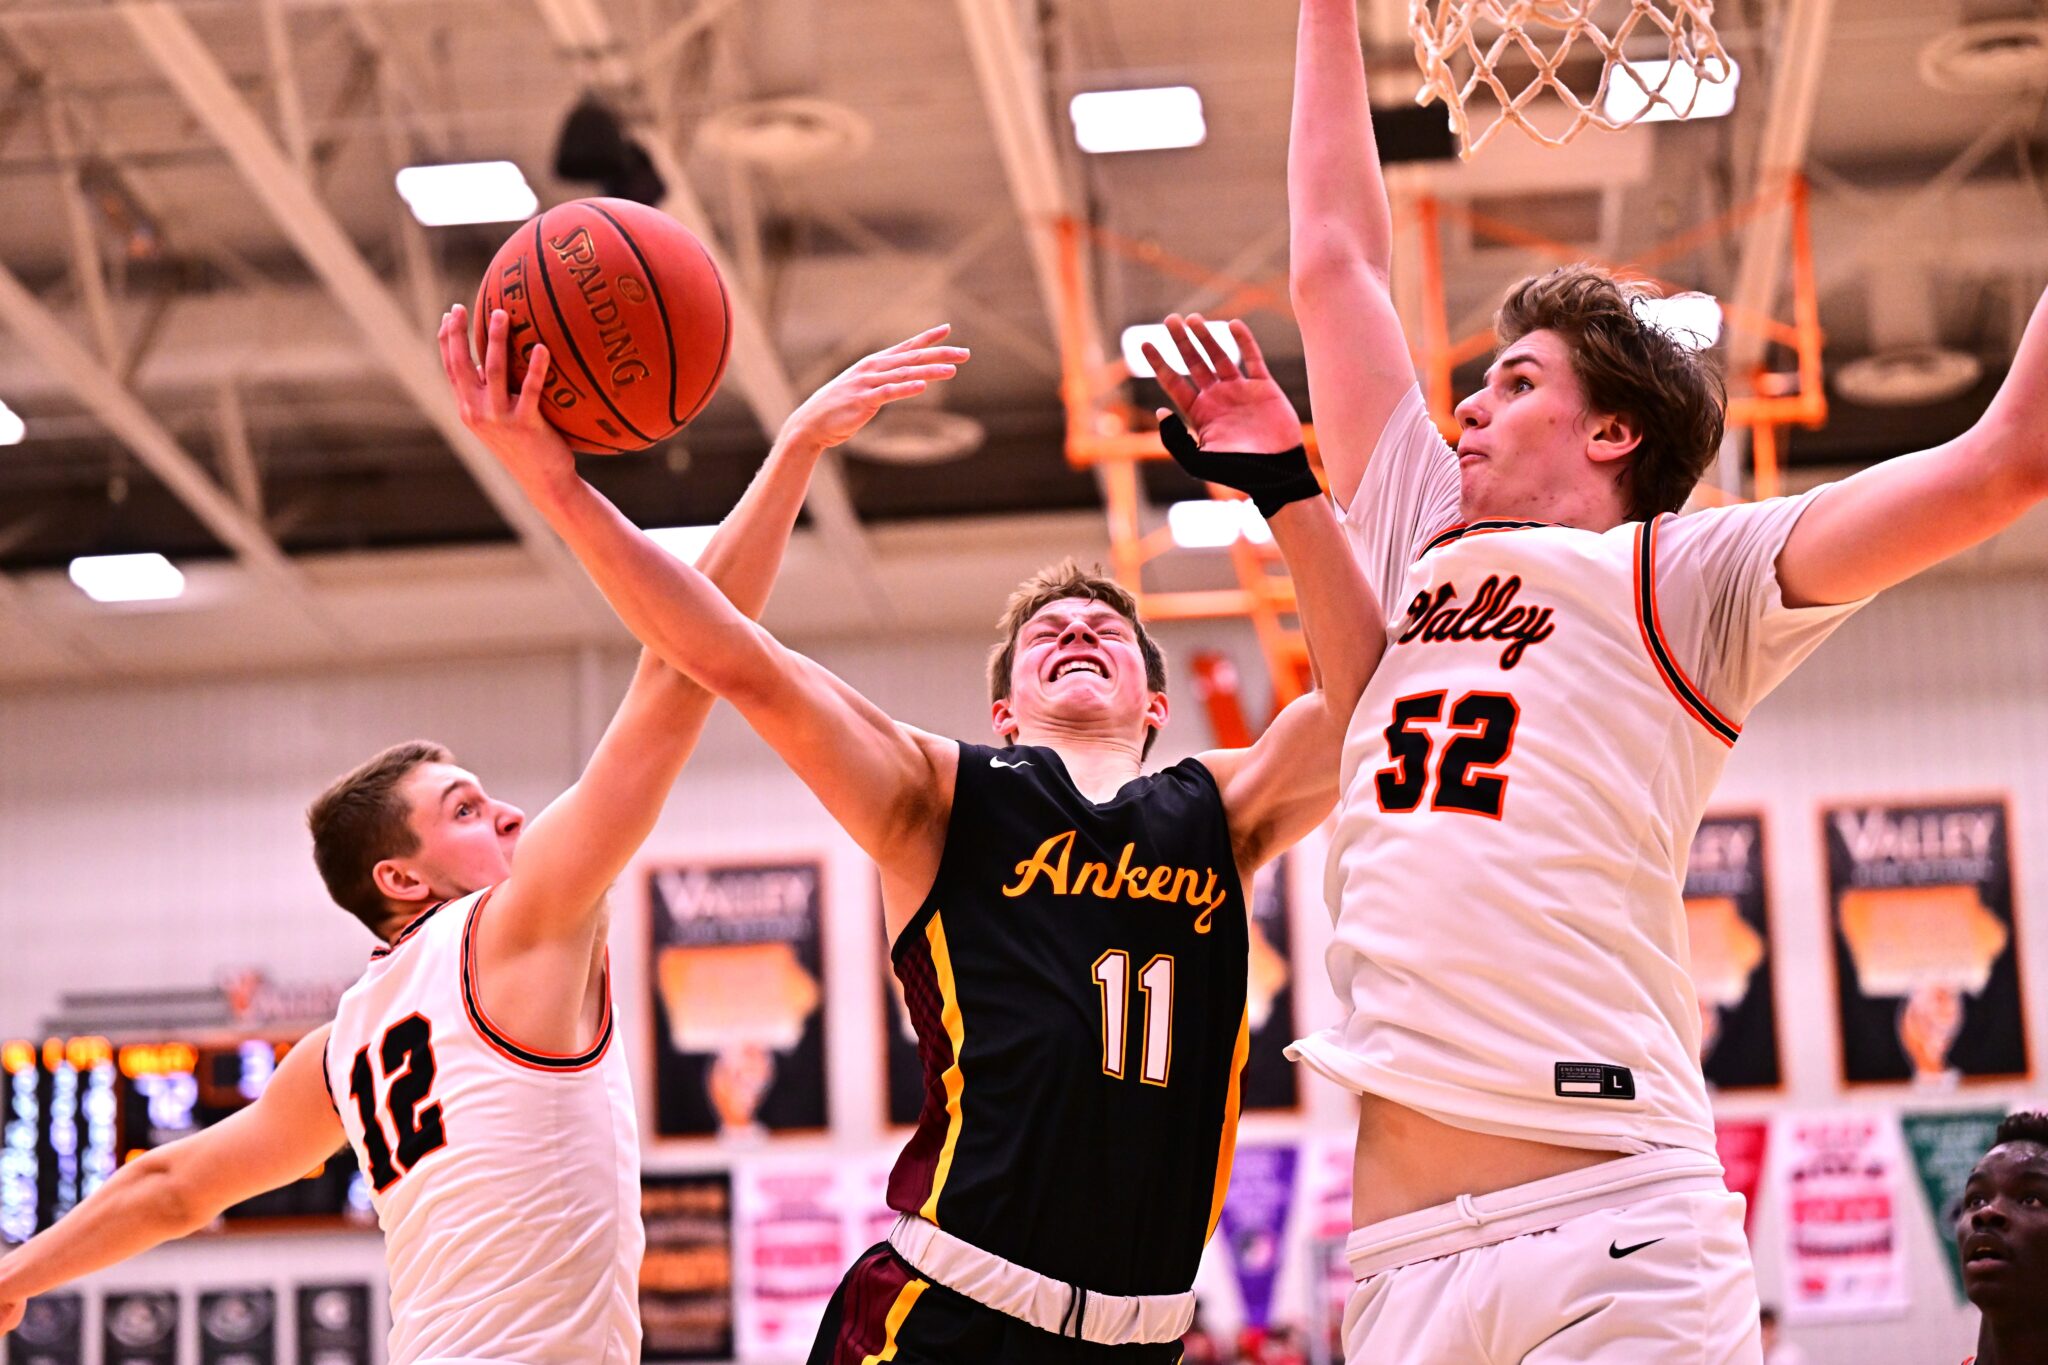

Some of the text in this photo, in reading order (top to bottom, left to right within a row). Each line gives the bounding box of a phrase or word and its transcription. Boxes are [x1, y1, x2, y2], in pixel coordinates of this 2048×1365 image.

[548, 226, 650, 390] SPALDING
[1396, 573, 1556, 671] Valley
[1374, 688, 1521, 821] 52
[1002, 829, 1227, 935] Ankeny
[1091, 948, 1175, 1088] 11
[1612, 1075, 1623, 1089] L
[349, 1011, 448, 1194] 12
